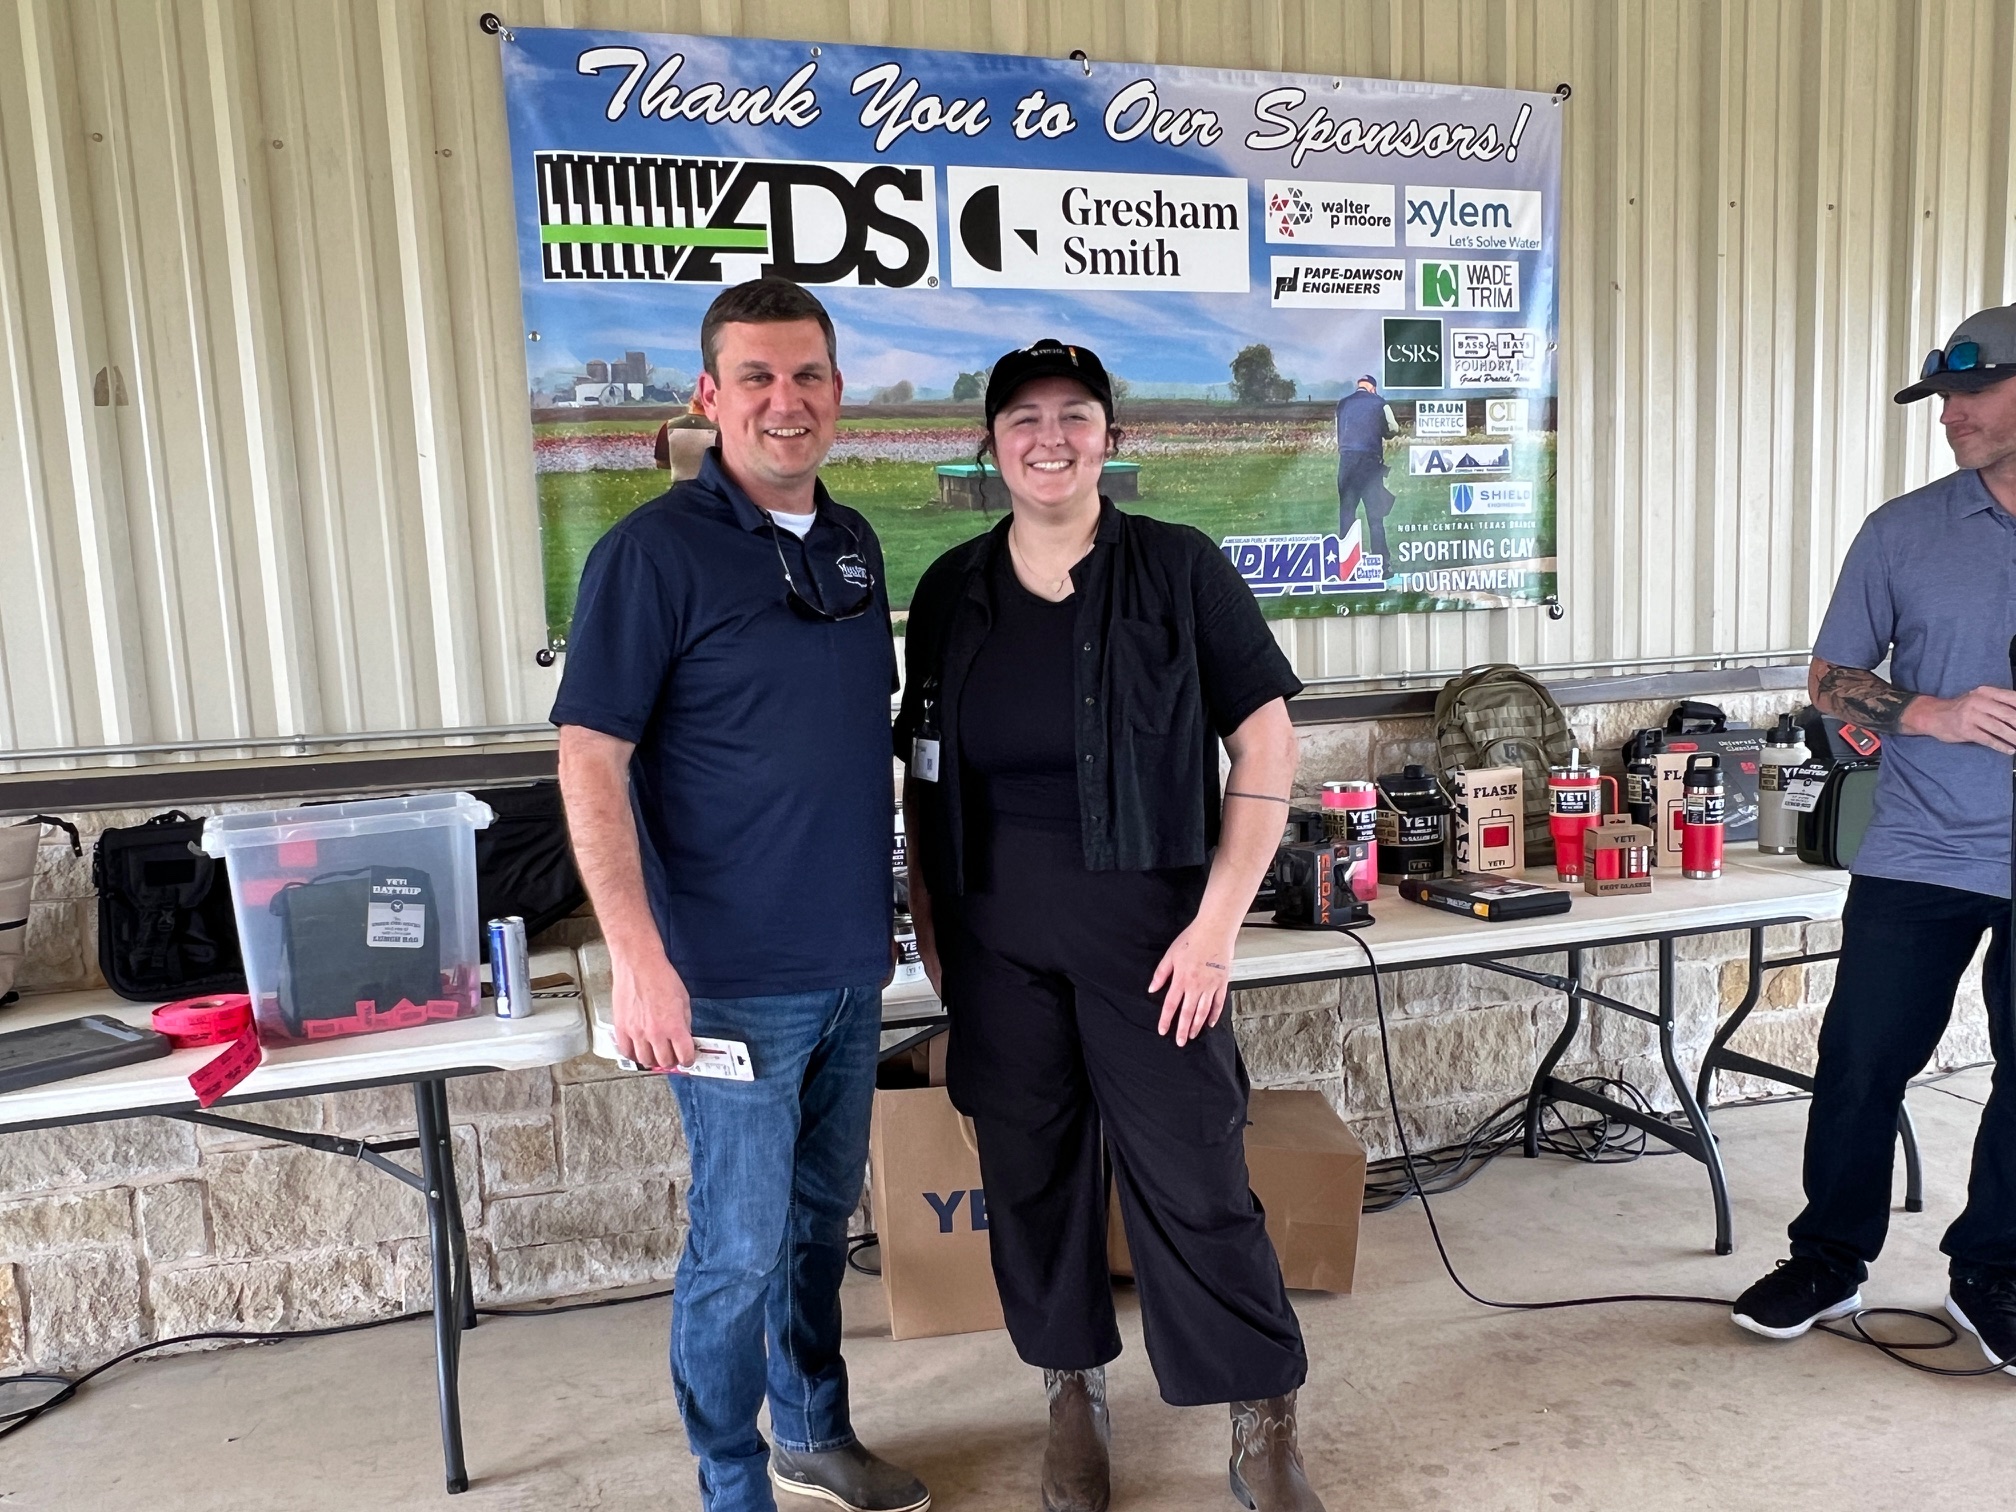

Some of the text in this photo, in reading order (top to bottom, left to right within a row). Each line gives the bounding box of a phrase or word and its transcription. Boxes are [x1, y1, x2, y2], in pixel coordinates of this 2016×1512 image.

[577, 45, 1532, 168] Thank You to Our Sponsors!
[1060, 186, 1240, 231] Gresham
[1321, 199, 1370, 216] walter
[1406, 189, 1512, 238] xylem
[672, 160, 936, 288] ADS
[1330, 213, 1392, 229] p moore
[1449, 235, 1540, 250] Let's Solve Water
[1063, 237, 1181, 277] Smith
[1304, 267, 1403, 282] PAPE-DAWSON
[1466, 264, 1512, 286] WADE
[1302, 282, 1381, 295] ENGINEERS
[1467, 286, 1513, 308] TRIM
[1457, 341, 1485, 350] BASS
[1387, 344, 1440, 363] CSRS
[1419, 403, 1463, 414] BRAUN
[1418, 417, 1464, 428] INTERTEC
[1480, 490, 1530, 501] SHIELD
[1398, 523, 1428, 532] NORTH
[1433, 522, 1475, 531] CENTRAL
[1479, 521, 1506, 530] TEXAS
[1399, 539, 1495, 562] SPORTING
[1356, 567, 1382, 580] Chapter
[1402, 569, 1528, 592] TOURNAMENT
[1473, 784, 1518, 799] FLASK
[1558, 792, 1587, 802] YETI
[1349, 809, 1377, 824] YETI
[1402, 815, 1438, 828] YETI
[1613, 835, 1636, 843] YETI
[1411, 861, 1431, 869] YETI
